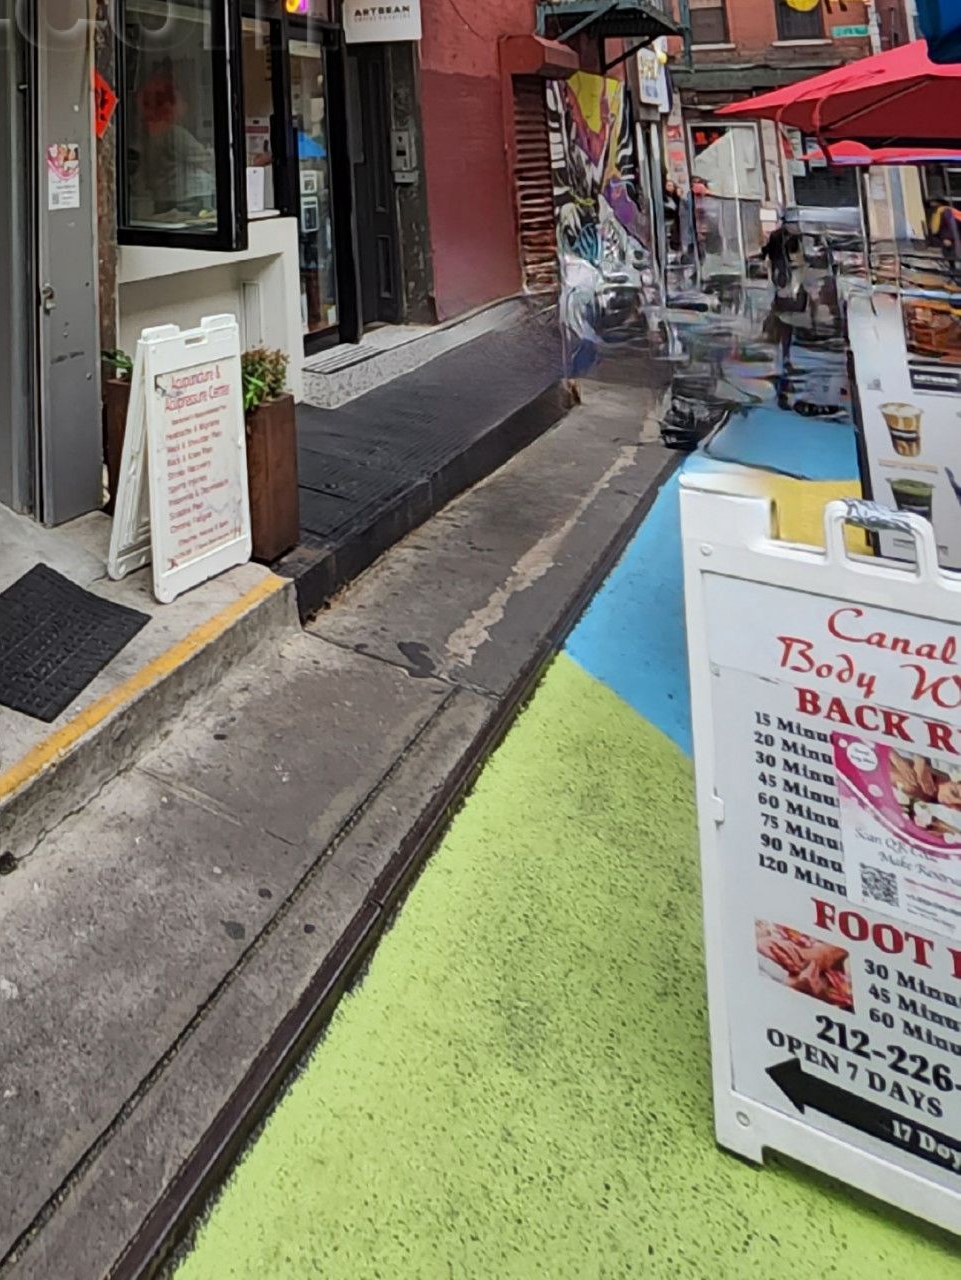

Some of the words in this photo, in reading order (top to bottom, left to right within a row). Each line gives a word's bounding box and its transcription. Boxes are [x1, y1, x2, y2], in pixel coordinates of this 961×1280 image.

[354, 4, 411, 18] ARTBEAN
[827, 607, 958, 665] Canal
[776, 635, 878, 699] Body
[754, 711, 772, 727] 15
[794, 686, 915, 744] BACK
[923, 720, 961, 756] R
[753, 730, 775, 748] 20
[755, 751, 776, 767] 30
[757, 791, 780, 809] 60
[758, 771, 778, 788] 45
[782, 777, 840, 808] Minu
[760, 812, 780, 830] 75
[784, 819, 844, 852] Minu
[760, 833, 783, 852] 90
[757, 852, 789, 875] 120
[810, 897, 935, 969] FOOT
[863, 958, 889, 981] 30
[895, 969, 961, 1008] Minu
[868, 983, 891, 1004] 45
[869, 1007, 895, 1029] 60
[766, 1028, 840, 1075] OPEN
[846, 1061, 859, 1081] 7
[865, 1068, 944, 1119] DAYS
[891, 1119, 913, 1144] 17
